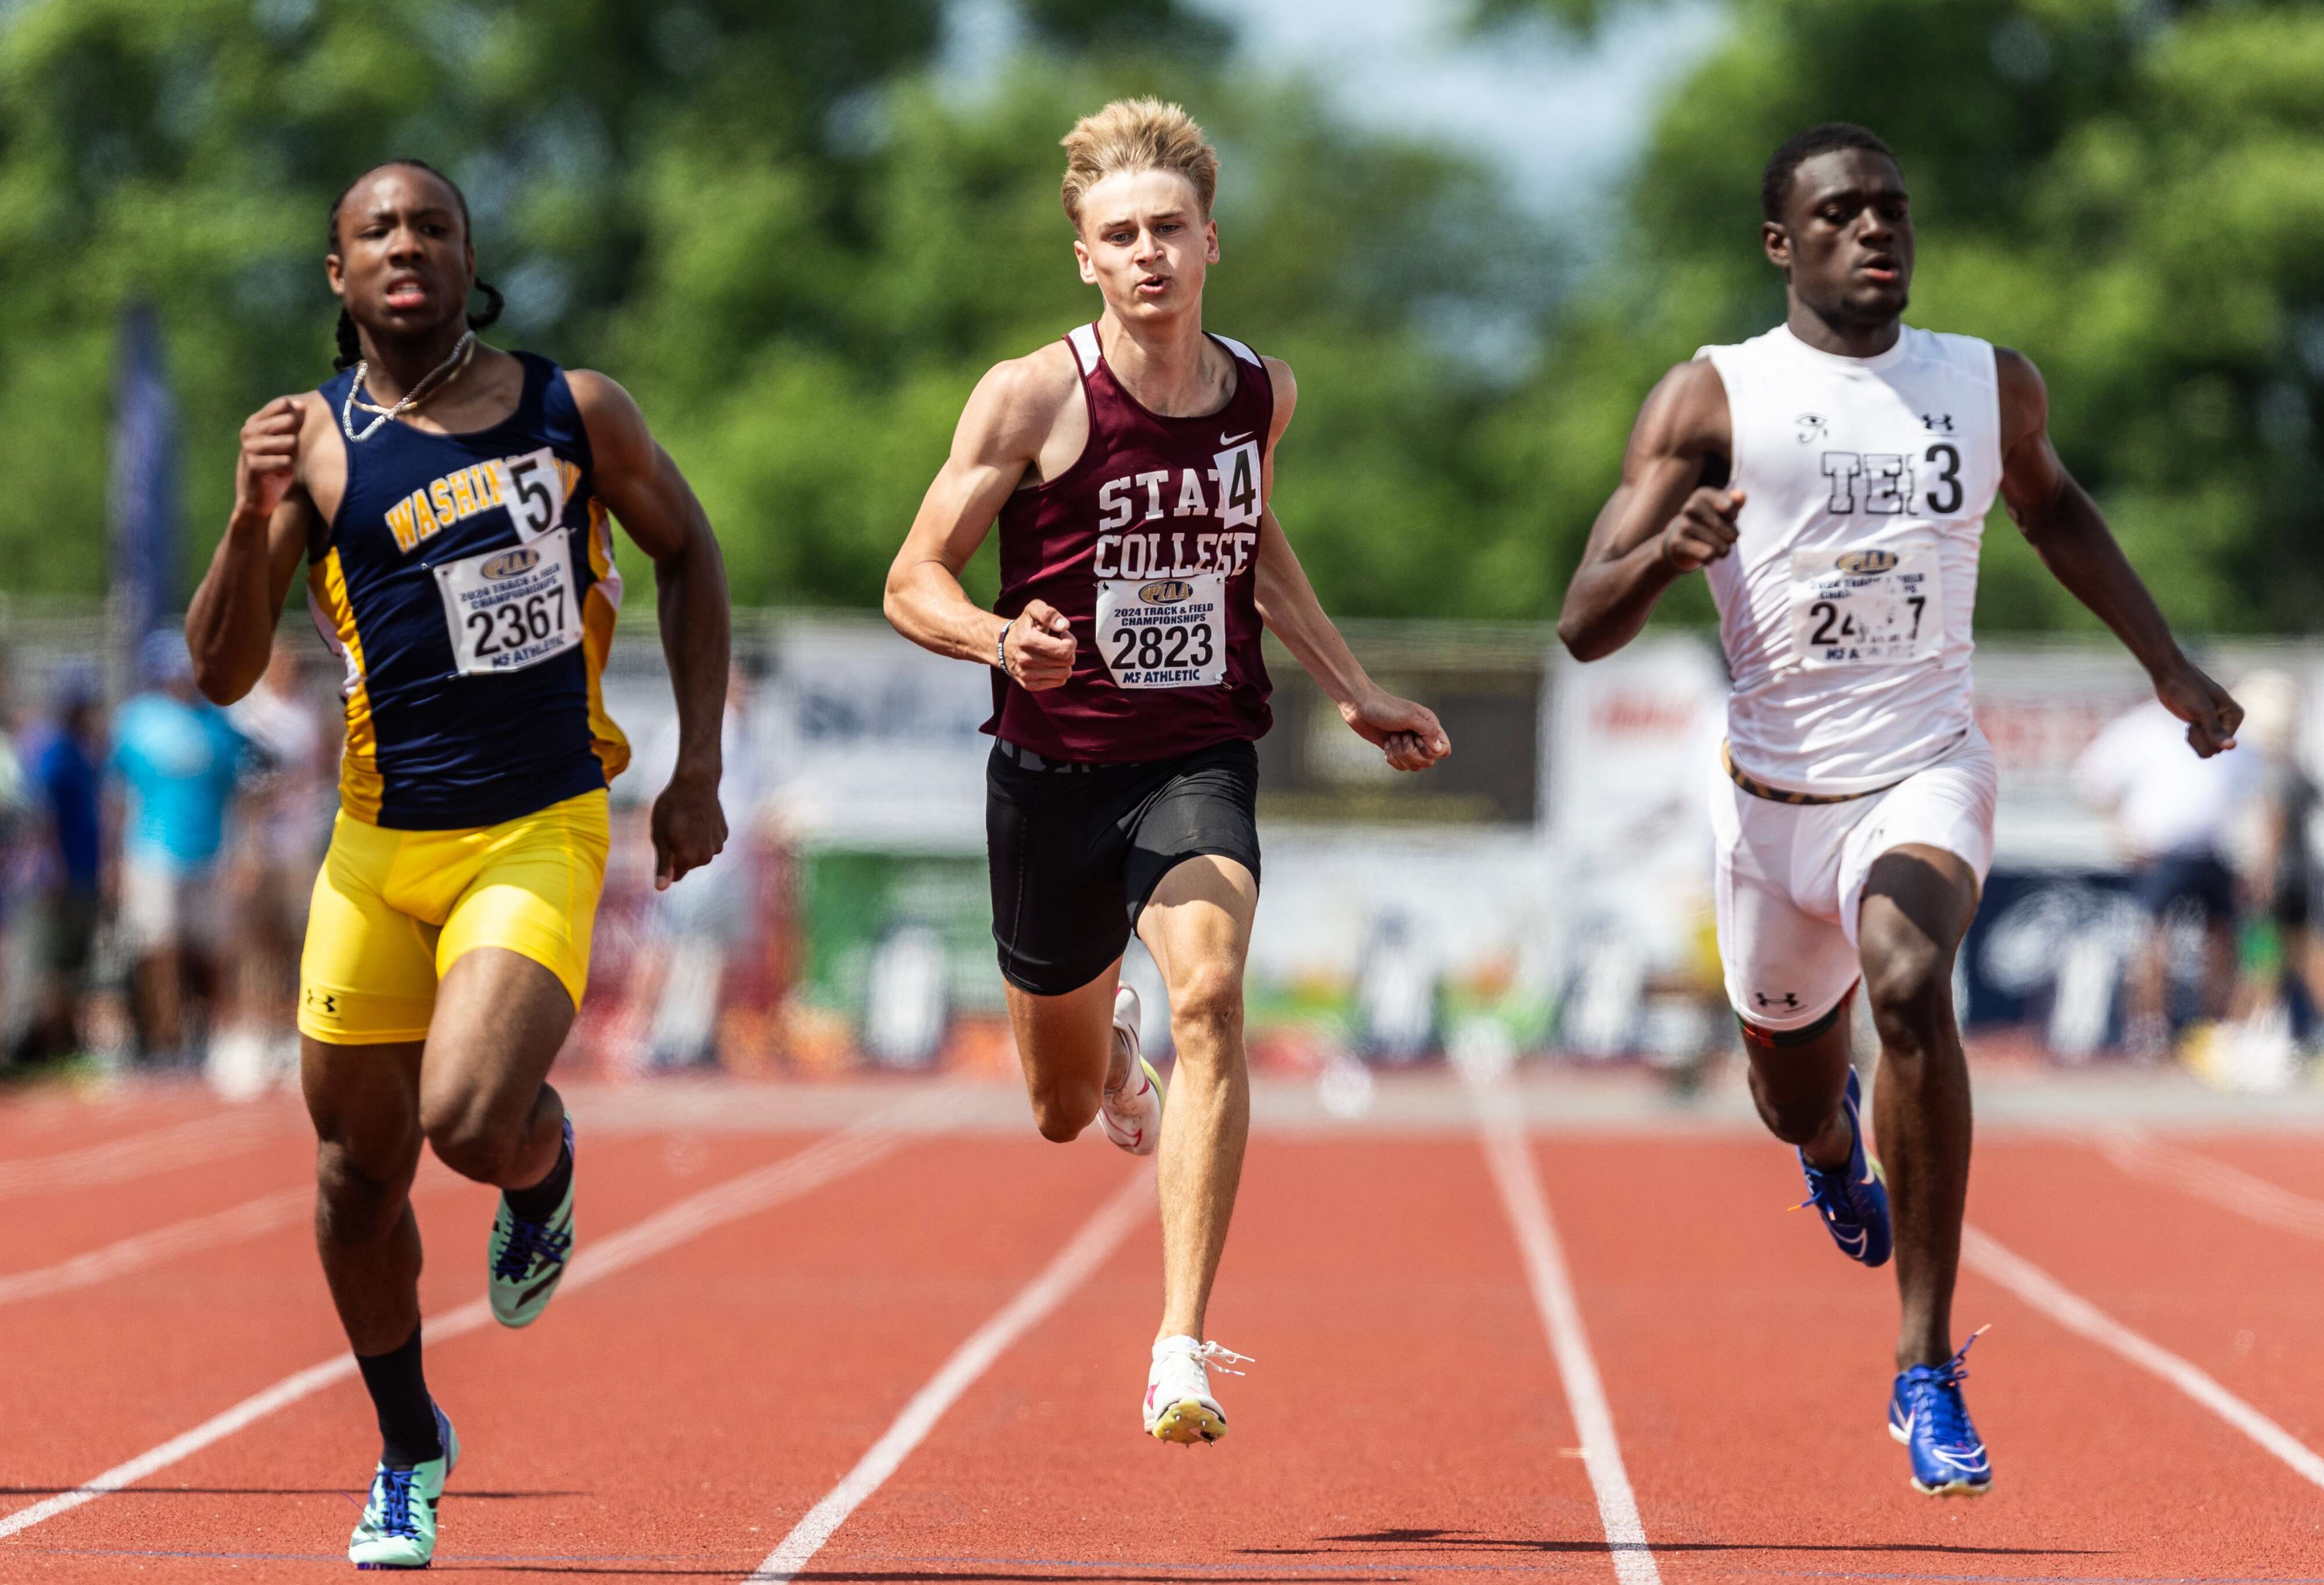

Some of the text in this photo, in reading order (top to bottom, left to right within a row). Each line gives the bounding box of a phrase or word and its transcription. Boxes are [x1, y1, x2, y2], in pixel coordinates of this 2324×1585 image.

[510, 458, 551, 532] 5
[1229, 449, 1256, 516] 4
[1925, 443, 1963, 514] 3
[1093, 533, 1256, 579] COLLEGE
[1114, 608, 1141, 617] 2024
[1144, 606, 1177, 616] TRACK
[1189, 603, 1213, 612] FIELD
[1147, 582, 1190, 601] PIAA
[467, 584, 564, 657] 2367
[1122, 614, 1206, 626] CHAMPIONSHIPS
[1110, 623, 1213, 669] 2823
[1143, 669, 1200, 683] ATHLETIC
